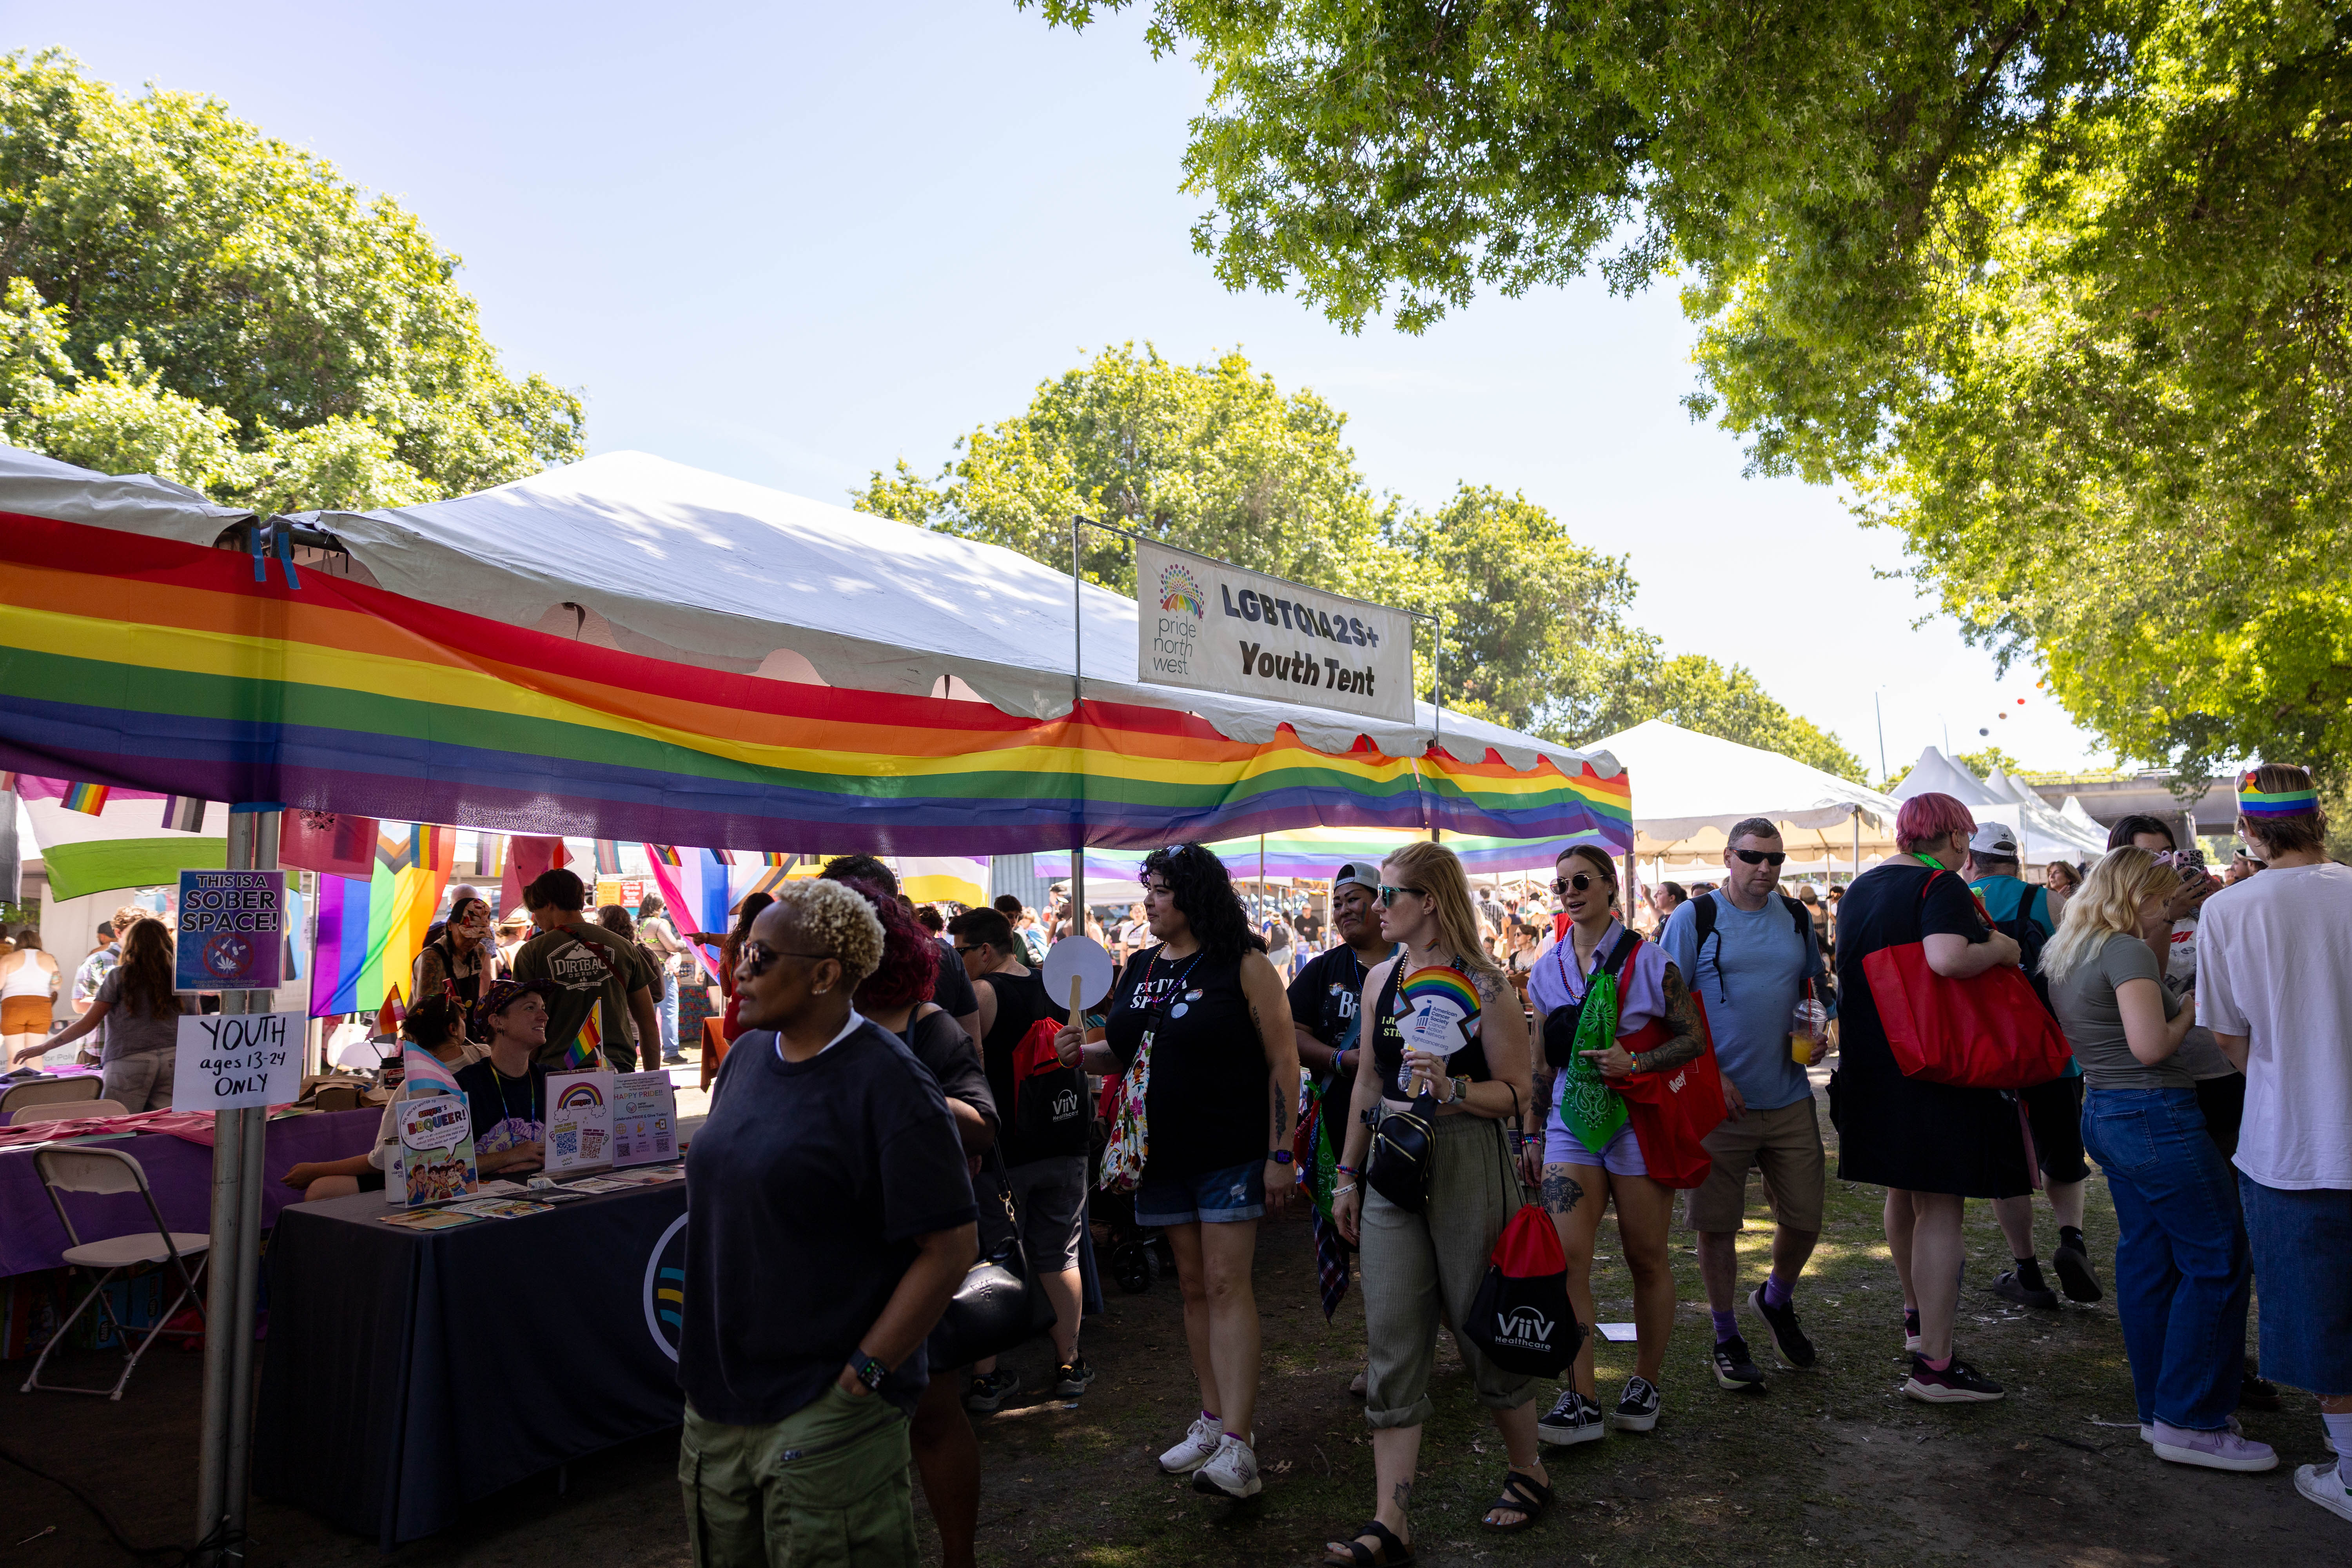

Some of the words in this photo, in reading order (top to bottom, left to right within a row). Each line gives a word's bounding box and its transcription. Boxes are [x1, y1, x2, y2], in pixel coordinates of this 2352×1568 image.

[1221, 583, 1379, 648] LGBTQIA2S+
[1159, 617, 1196, 639] pride
[1154, 635, 1193, 658] north
[1153, 657, 1188, 675] west
[1239, 641, 1320, 686] Youth
[1325, 657, 1375, 697] Tent
[196, 875, 234, 888] THIS
[236, 875, 252, 888] IS
[253, 875, 268, 888] A
[184, 890, 278, 910] SOBER
[180, 912, 278, 932] SPACE!
[1381, 1016, 1386, 1024] I
[1430, 1016, 1449, 1026] Society
[1431, 1011, 1450, 1020] Cancer
[1432, 1006, 1458, 1018] American
[200, 1016, 286, 1050] YOUTH
[1426, 1026, 1443, 1034] Action
[1428, 1021, 1446, 1030] Cancer
[1411, 1035, 1449, 1051] fightcancer.org
[200, 1058, 241, 1076] ages
[247, 1051, 285, 1069] 13-24
[214, 1073, 268, 1096] ONLY
[613, 1092, 637, 1100] HAPPY
[639, 1089, 663, 1098] PRIDE!!
[1052, 1094, 1078, 1115] ViiV
[407, 1109, 466, 1135] BBQUEER!
[1053, 1110, 1079, 1121] Healthcare
[1497, 1312, 1555, 1341] ViiV
[1495, 1336, 1551, 1350] Healthcare
